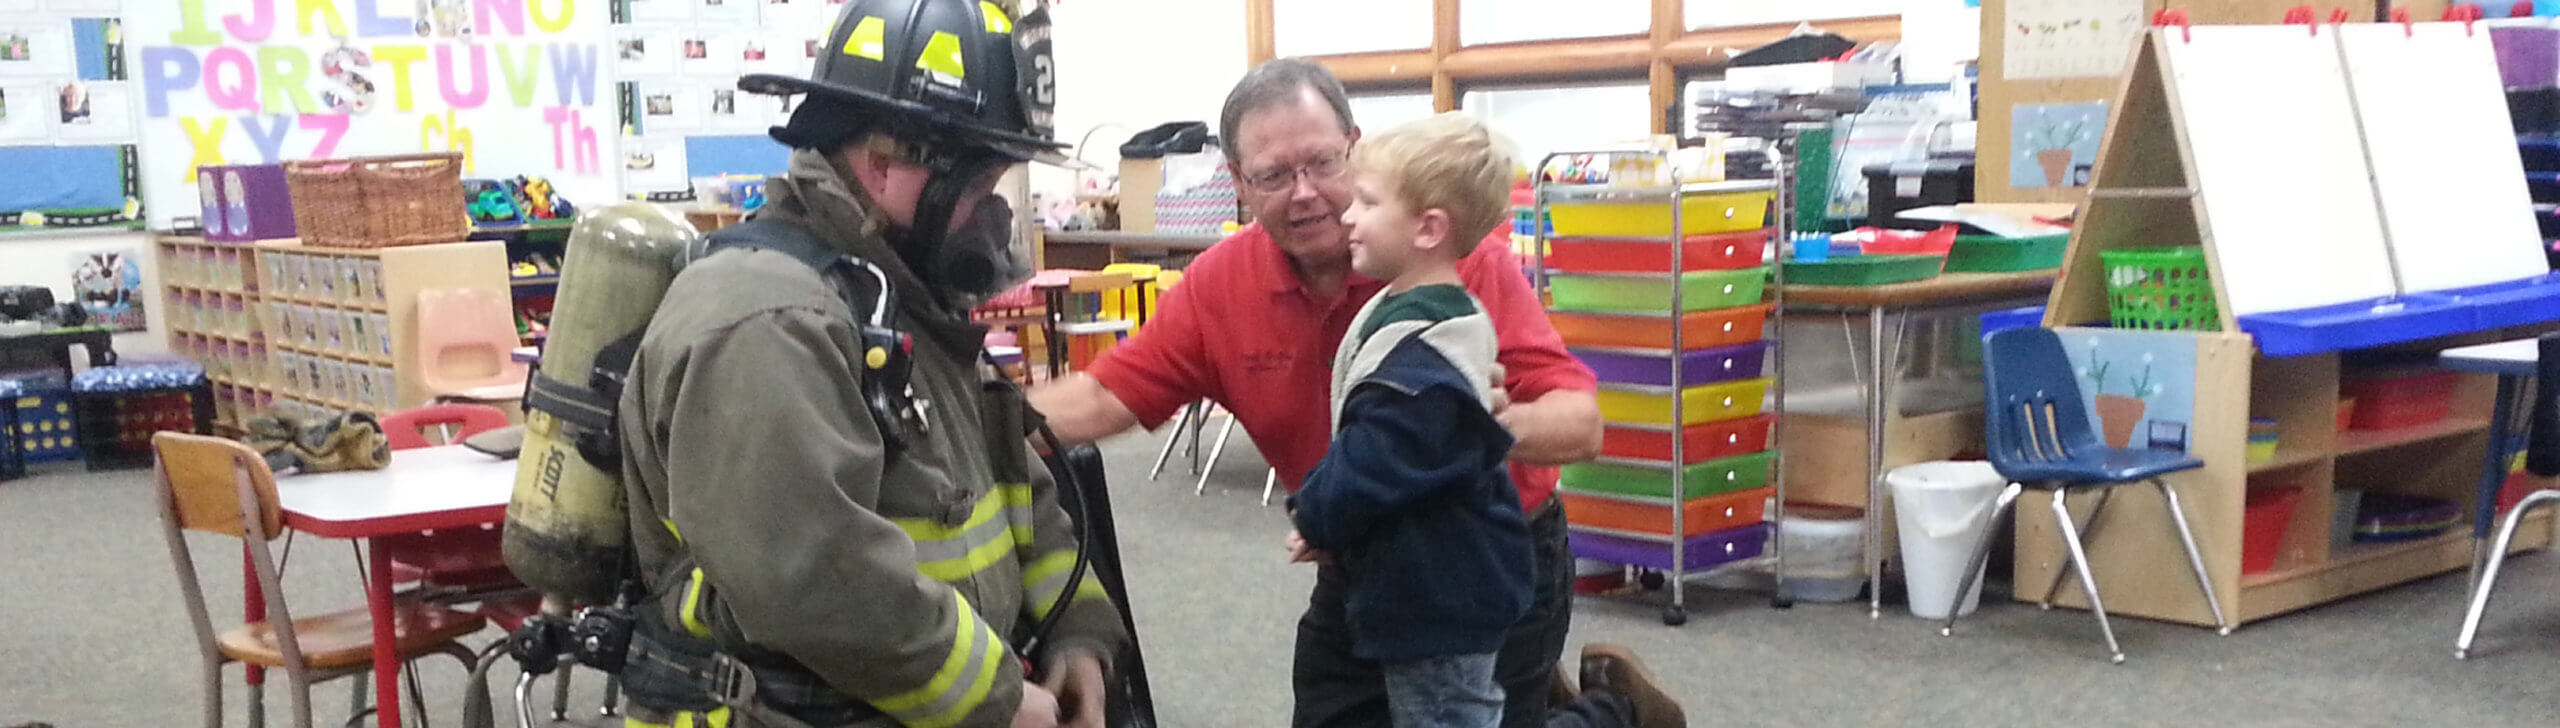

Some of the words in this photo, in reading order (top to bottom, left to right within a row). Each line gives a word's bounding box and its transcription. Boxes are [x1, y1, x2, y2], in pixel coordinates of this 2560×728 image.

[1034, 54, 1053, 105] 2
[544, 105, 600, 175] Th
[540, 444, 565, 501] SCOTT
